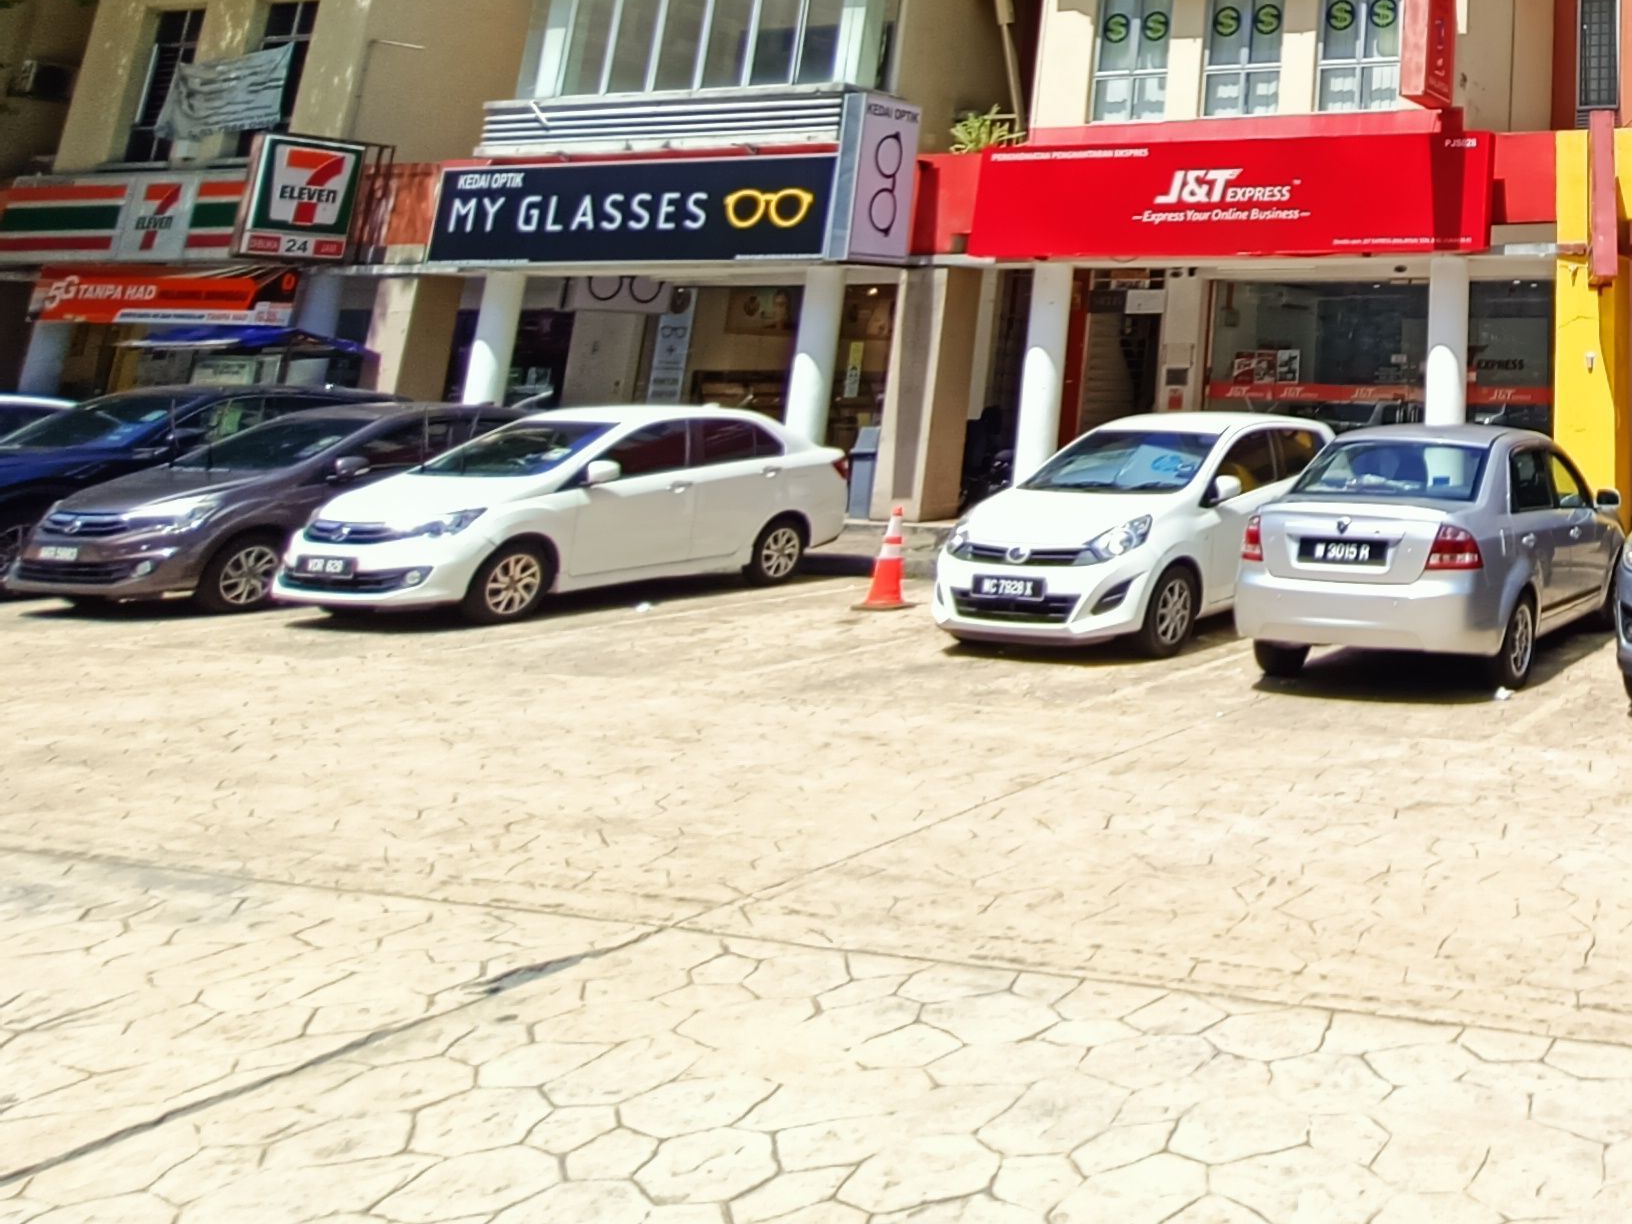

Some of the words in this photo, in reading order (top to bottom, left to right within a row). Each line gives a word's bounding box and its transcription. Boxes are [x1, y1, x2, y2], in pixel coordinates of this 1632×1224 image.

[286, 148, 346, 225] 7
[457, 174, 489, 189] KEDAI
[490, 172, 525, 188] OPTIK
[1153, 168, 1244, 204] J&T
[1225, 186, 1291, 203] EXPRESS
[447, 196, 506, 233] MY
[516, 191, 709, 232] GLASSES
[1186, 209, 1211, 222] Your
[1212, 207, 1249, 221] Online
[284, 238, 309, 253] 24
